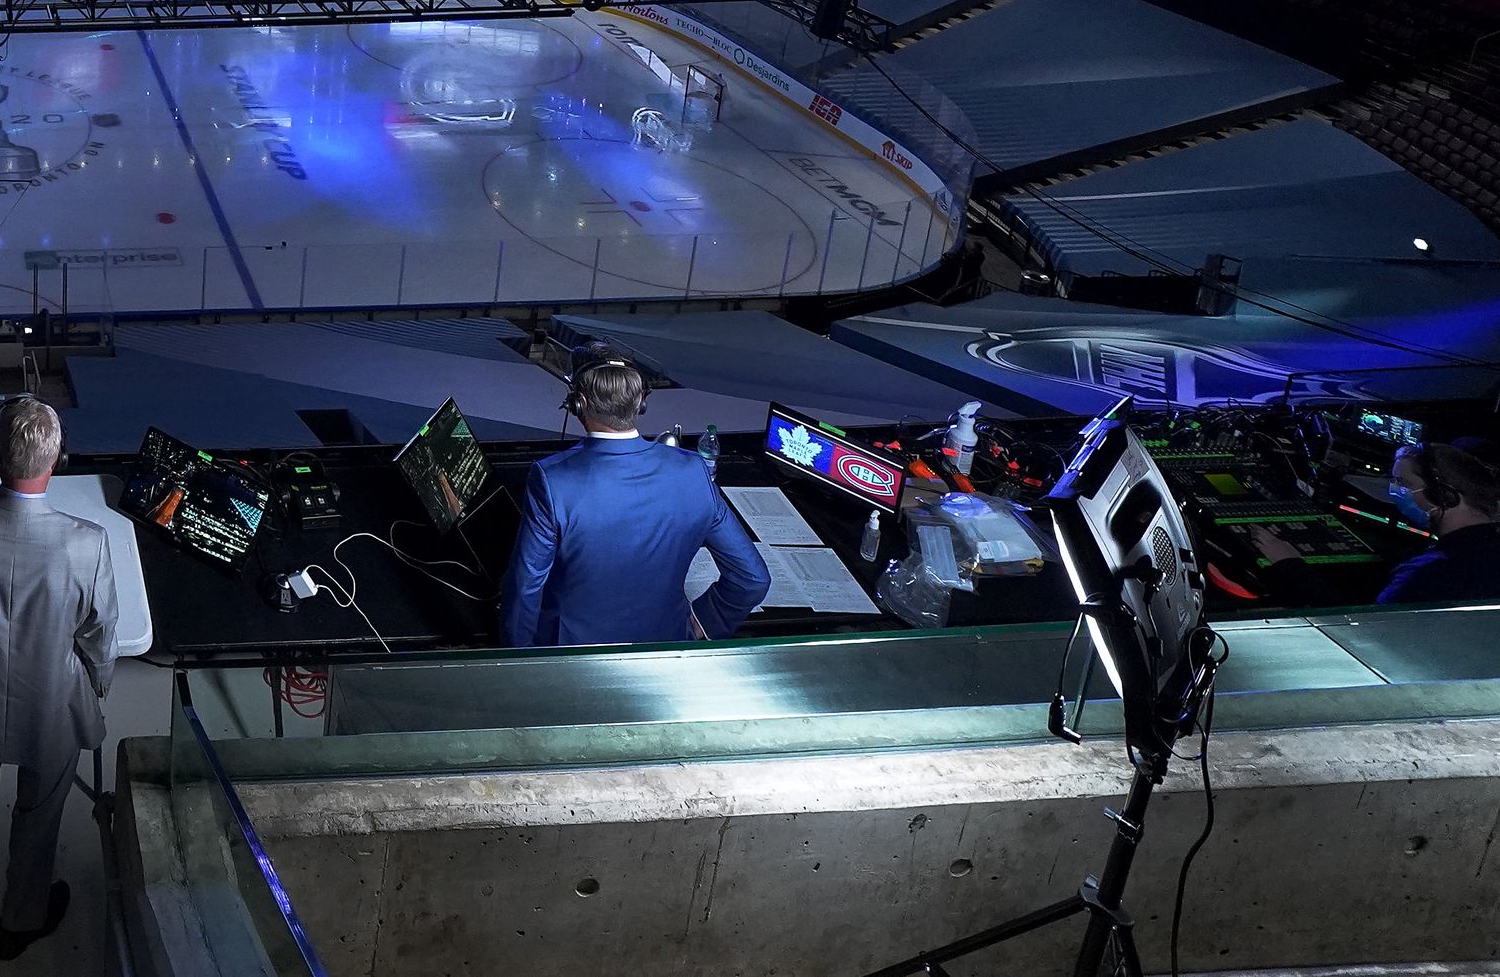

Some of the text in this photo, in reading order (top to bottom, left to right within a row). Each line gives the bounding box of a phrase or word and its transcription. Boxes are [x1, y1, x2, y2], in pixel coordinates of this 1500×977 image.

[746, 56, 791, 93] Desjardins
[807, 93, 845, 127] IGA
[894, 153, 913, 170] SKIP
[785, 438, 813, 455] TORONTO
